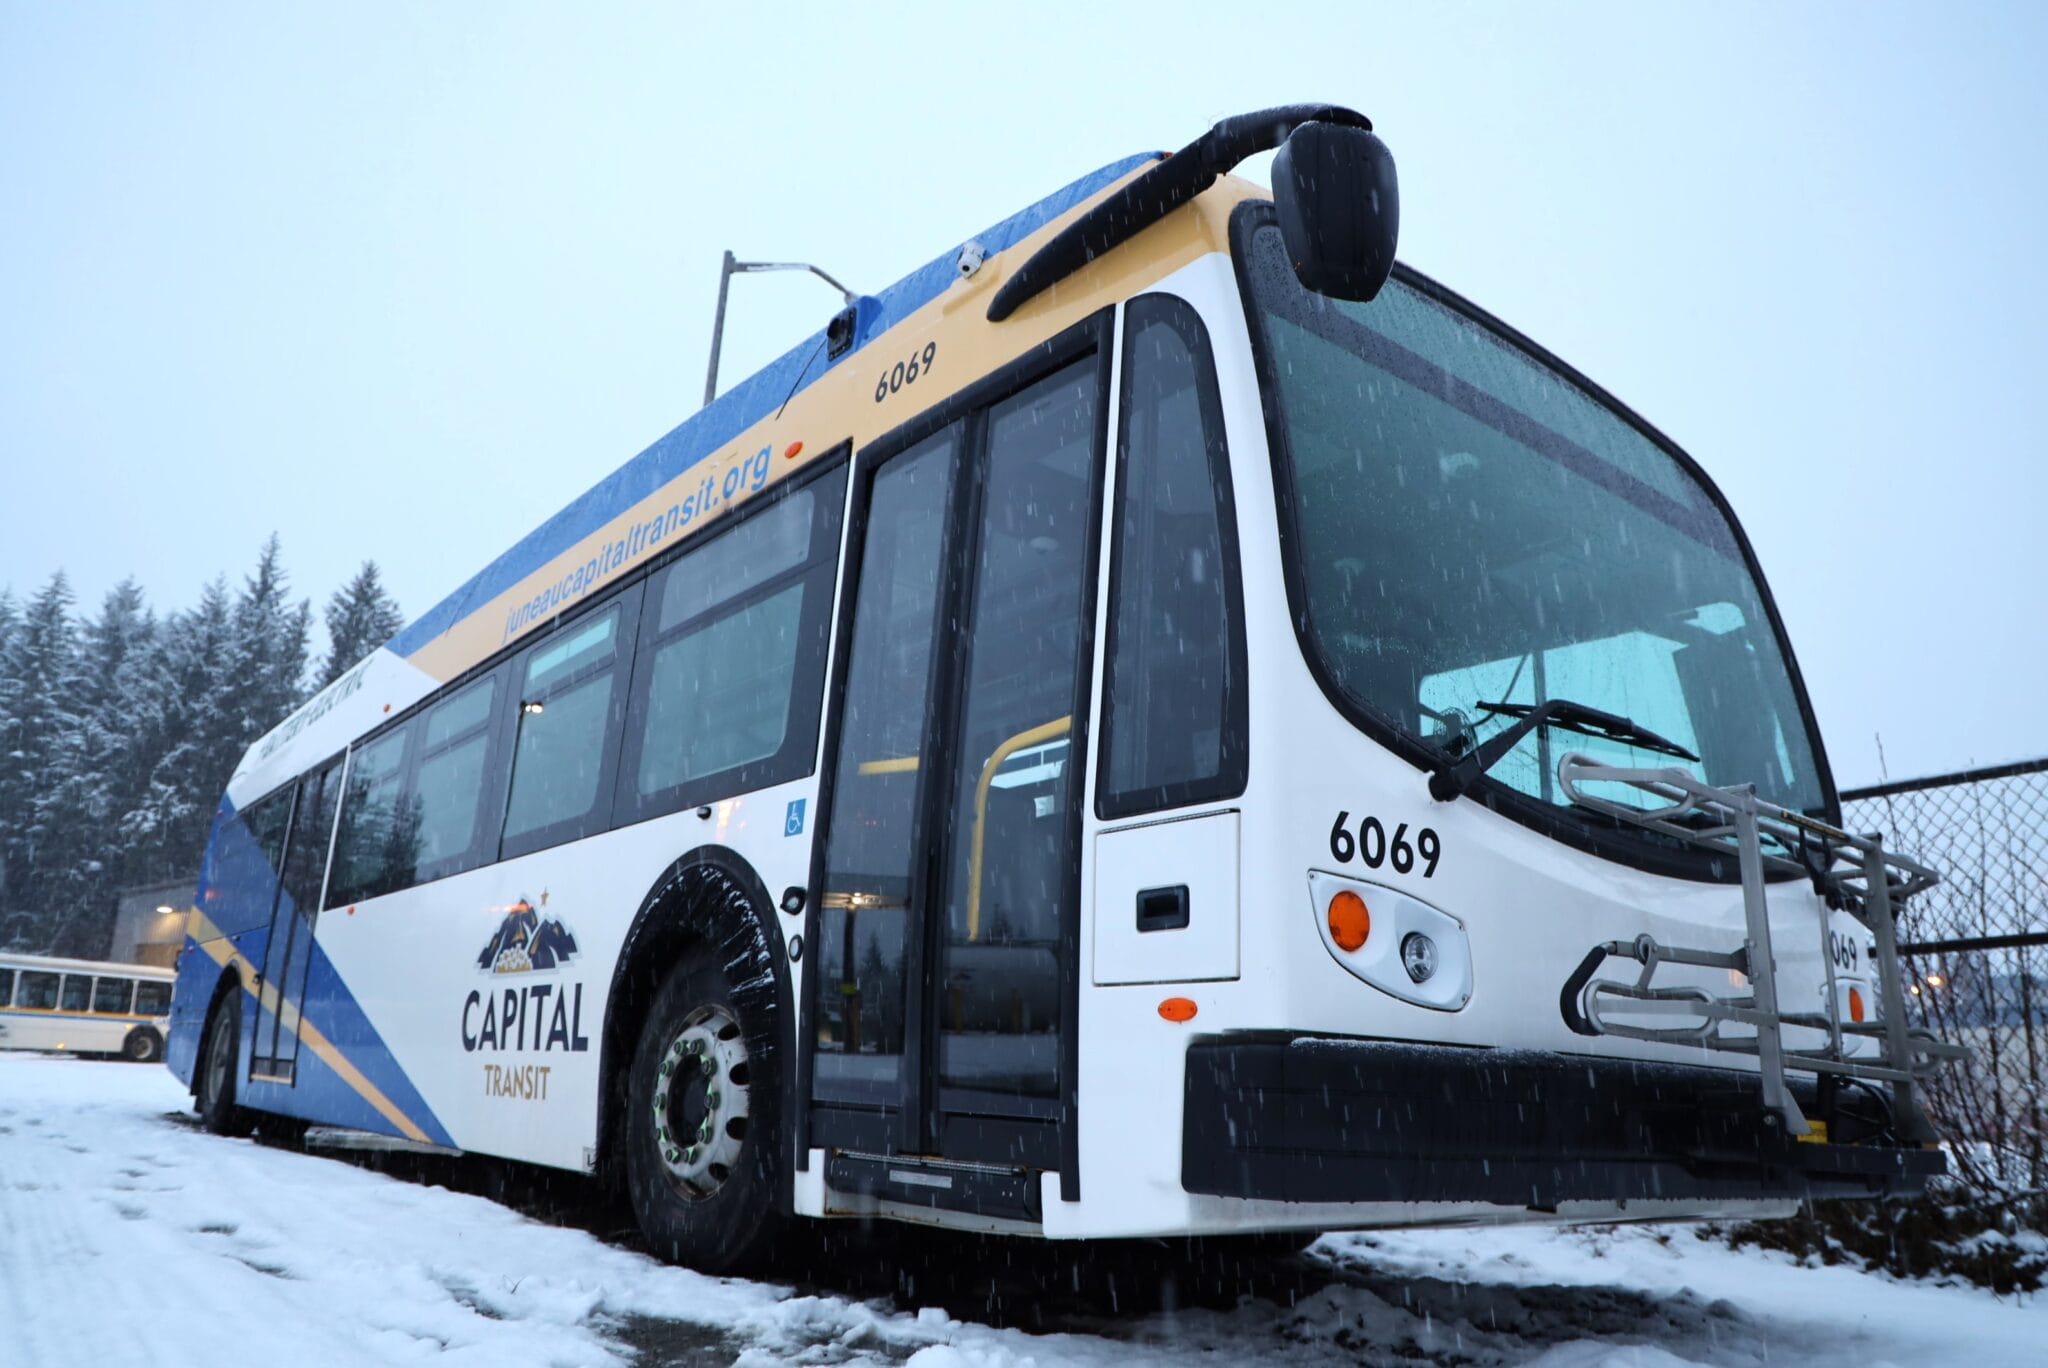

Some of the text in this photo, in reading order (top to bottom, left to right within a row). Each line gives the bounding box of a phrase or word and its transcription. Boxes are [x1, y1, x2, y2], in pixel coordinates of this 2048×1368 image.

[875, 341, 936, 403] 6069
[502, 444, 772, 645] juneaucapitaltransit.org
[1330, 810, 1441, 878] 6069
[1830, 930, 1857, 972] 069
[462, 982, 589, 1052] CAPITAL
[484, 1064, 550, 1100] TRANSIT
